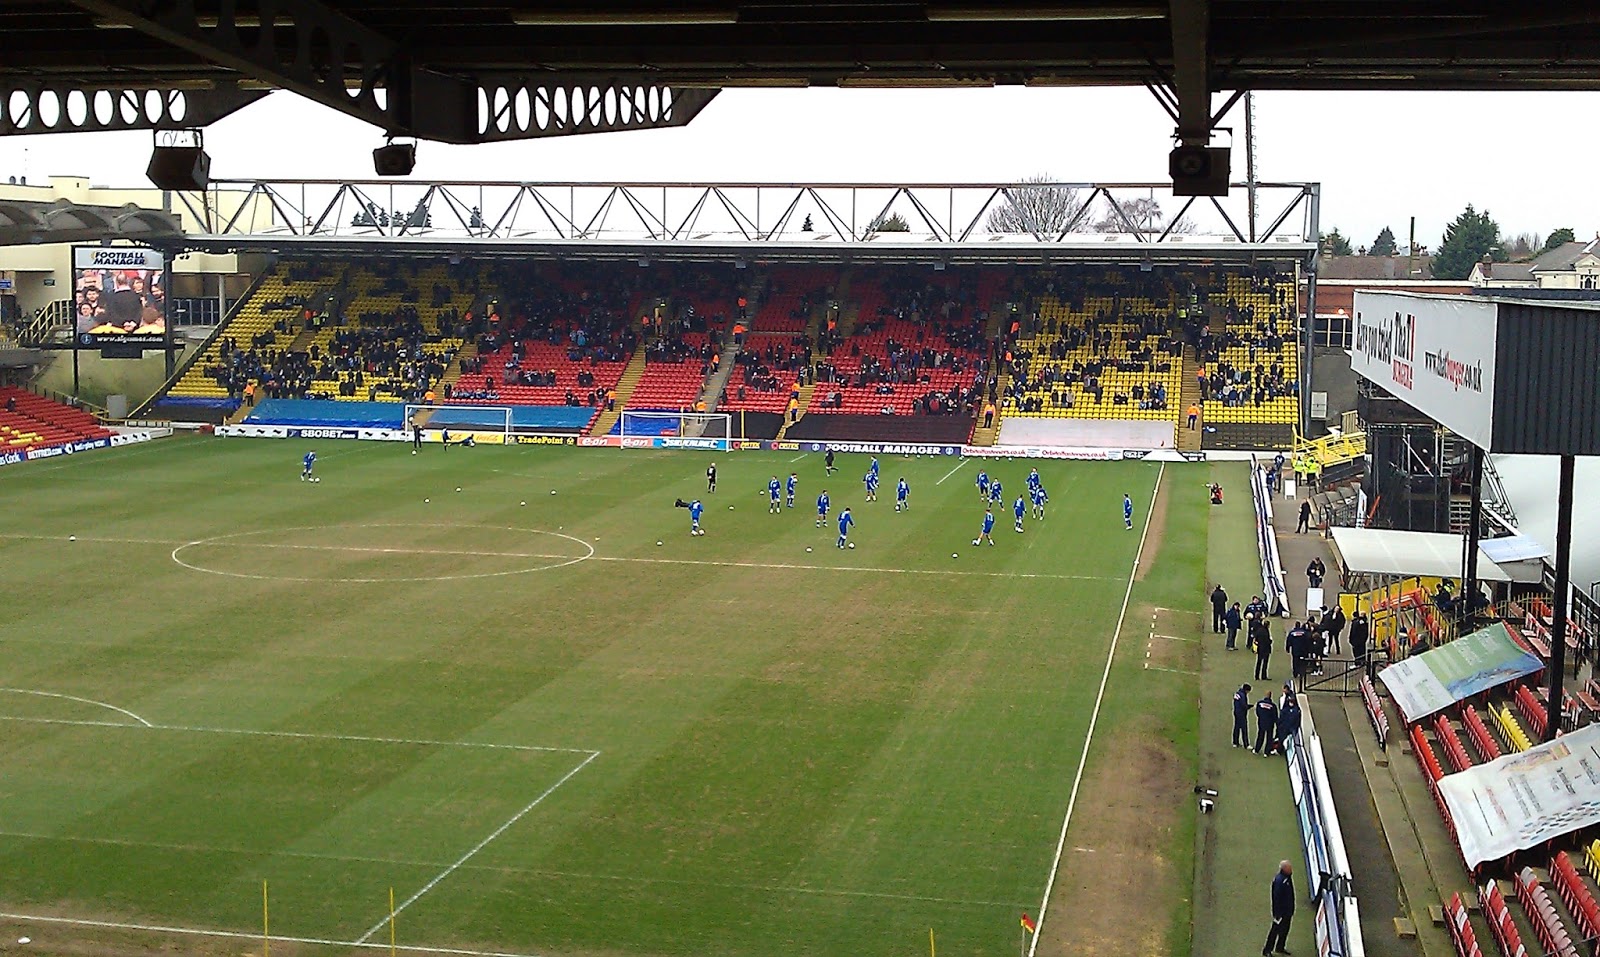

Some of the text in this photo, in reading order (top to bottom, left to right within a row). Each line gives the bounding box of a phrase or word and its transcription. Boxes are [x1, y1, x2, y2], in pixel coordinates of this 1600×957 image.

[1367, 325, 1378, 365] you
[518, 435, 564, 445] TradePoint
[825, 443, 941, 455] FOOTBALL MANAGER
